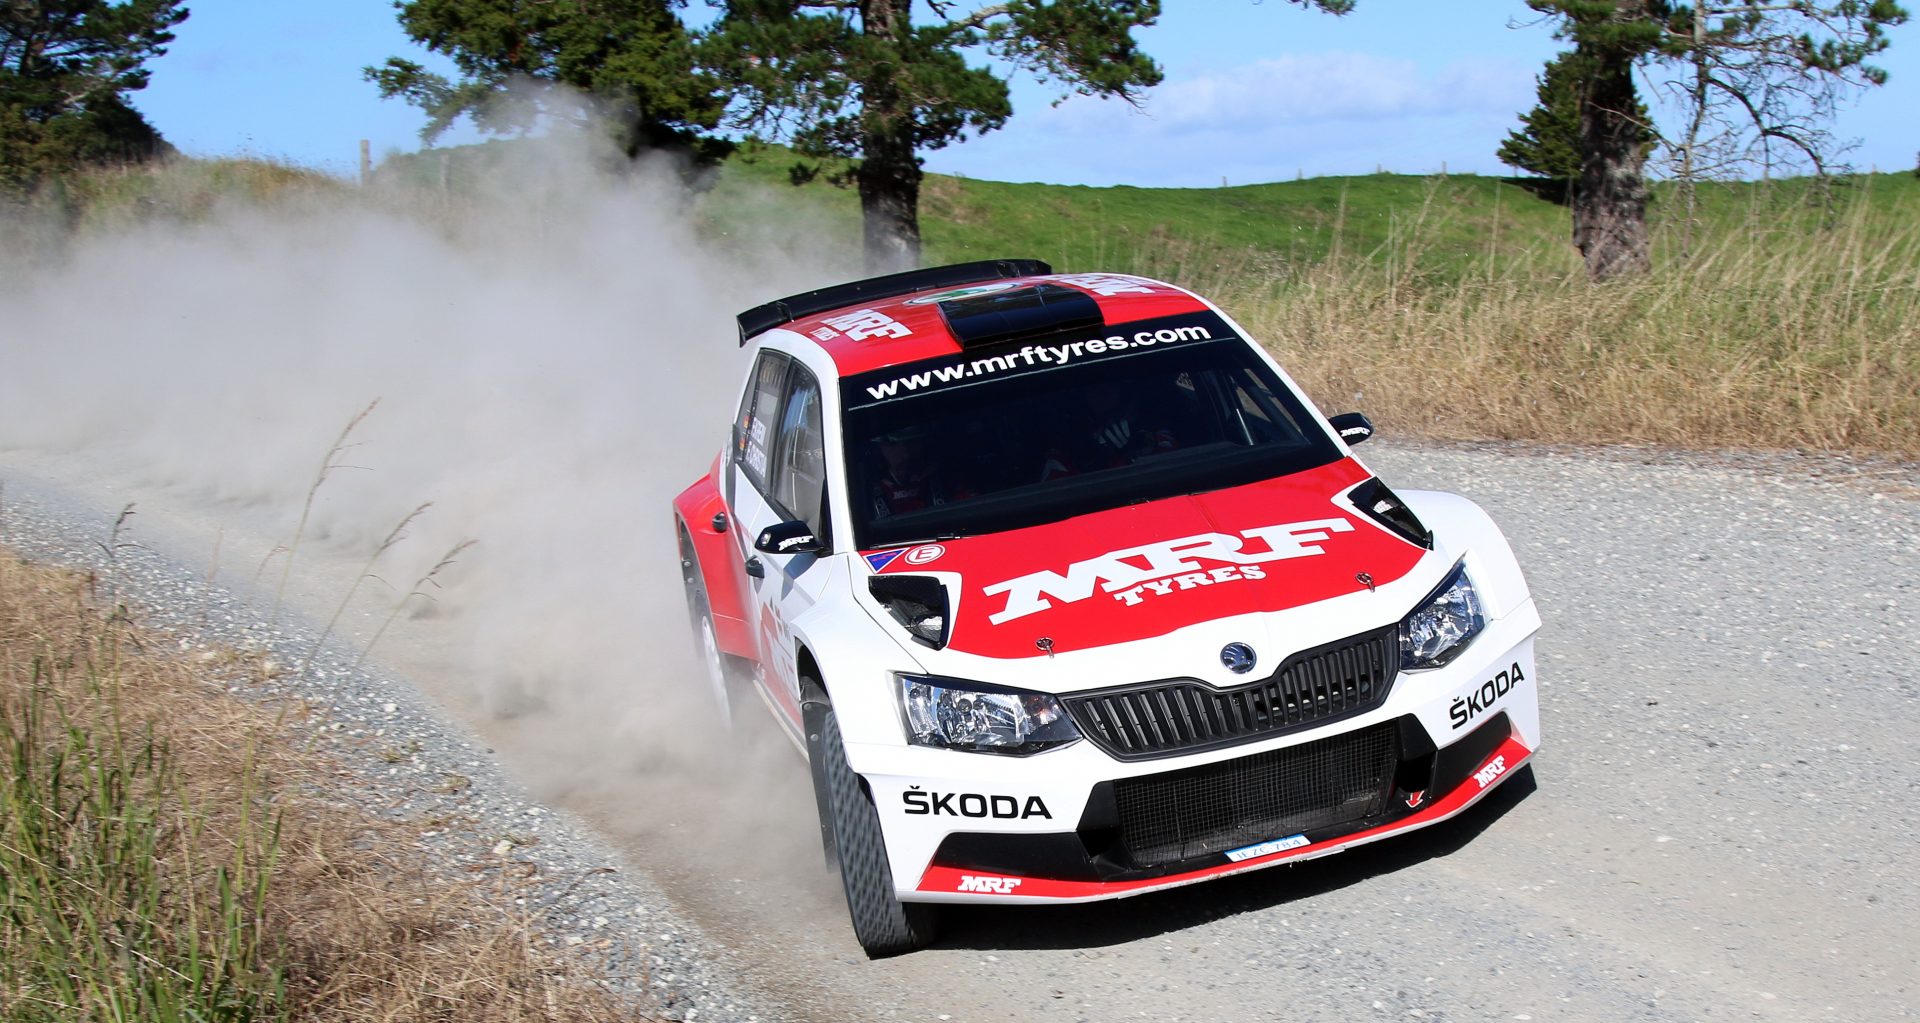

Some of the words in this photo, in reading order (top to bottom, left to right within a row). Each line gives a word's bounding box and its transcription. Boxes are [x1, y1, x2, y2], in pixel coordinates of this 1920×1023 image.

[866, 326, 1211, 400] www.mrftyres.com
[778, 535, 814, 551] MRF
[982, 518, 1355, 626] MRF
[1114, 565, 1267, 606] TYRES
[1450, 662, 1525, 730] ŠKODA
[1473, 755, 1507, 789] MRF
[902, 785, 1053, 820] ŠKODA
[957, 875, 1022, 894] MRF
